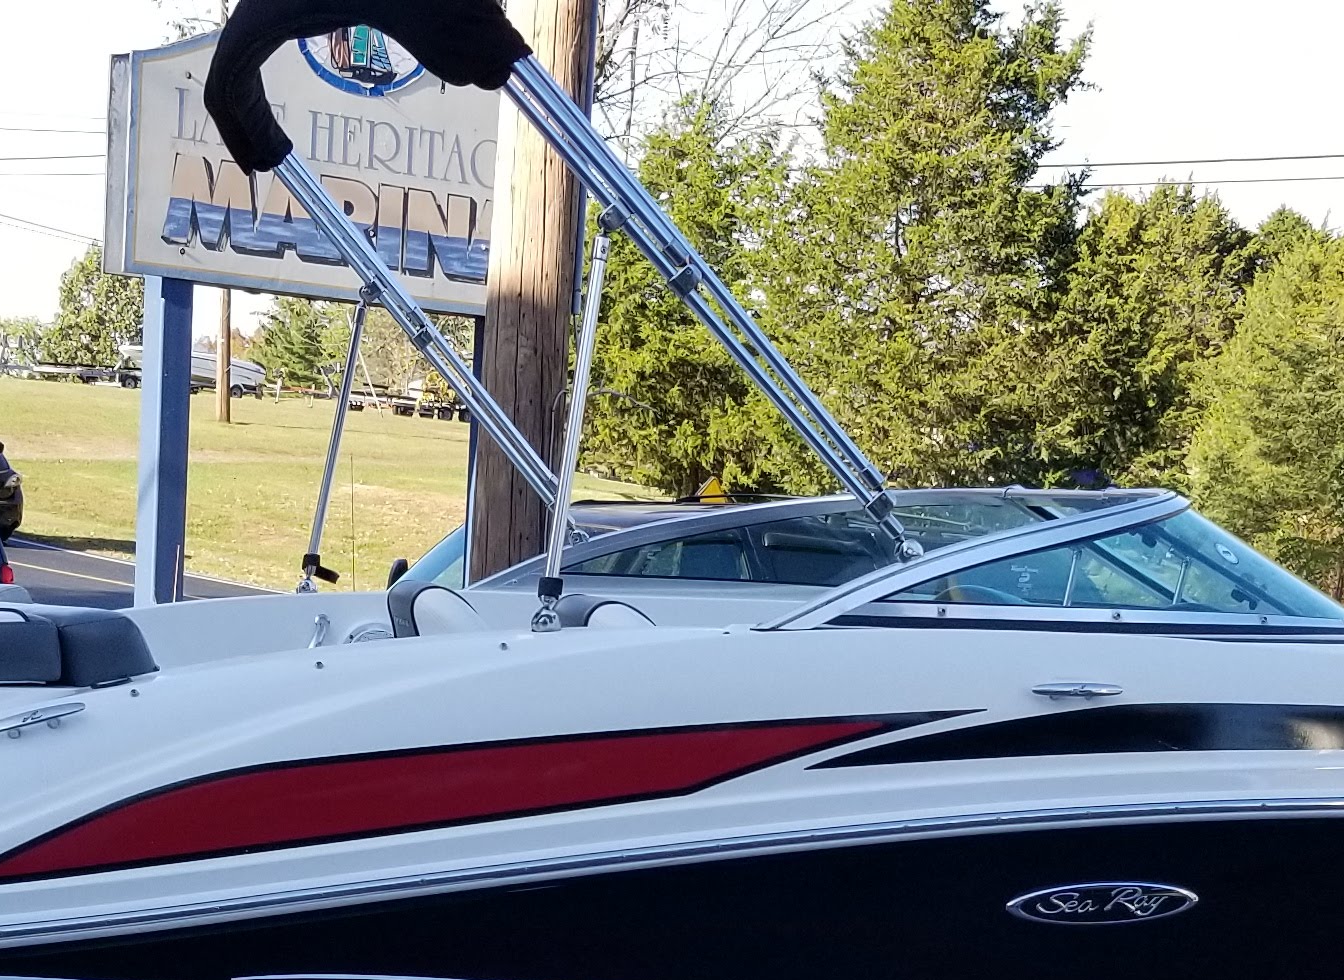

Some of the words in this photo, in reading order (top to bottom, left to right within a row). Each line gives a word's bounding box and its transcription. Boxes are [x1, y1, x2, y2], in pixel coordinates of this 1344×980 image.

[306, 110, 497, 190] HERITAG
[161, 152, 493, 285] MARIN
[1036, 892, 1099, 914] Sea
[1104, 886, 1168, 916] Ray
